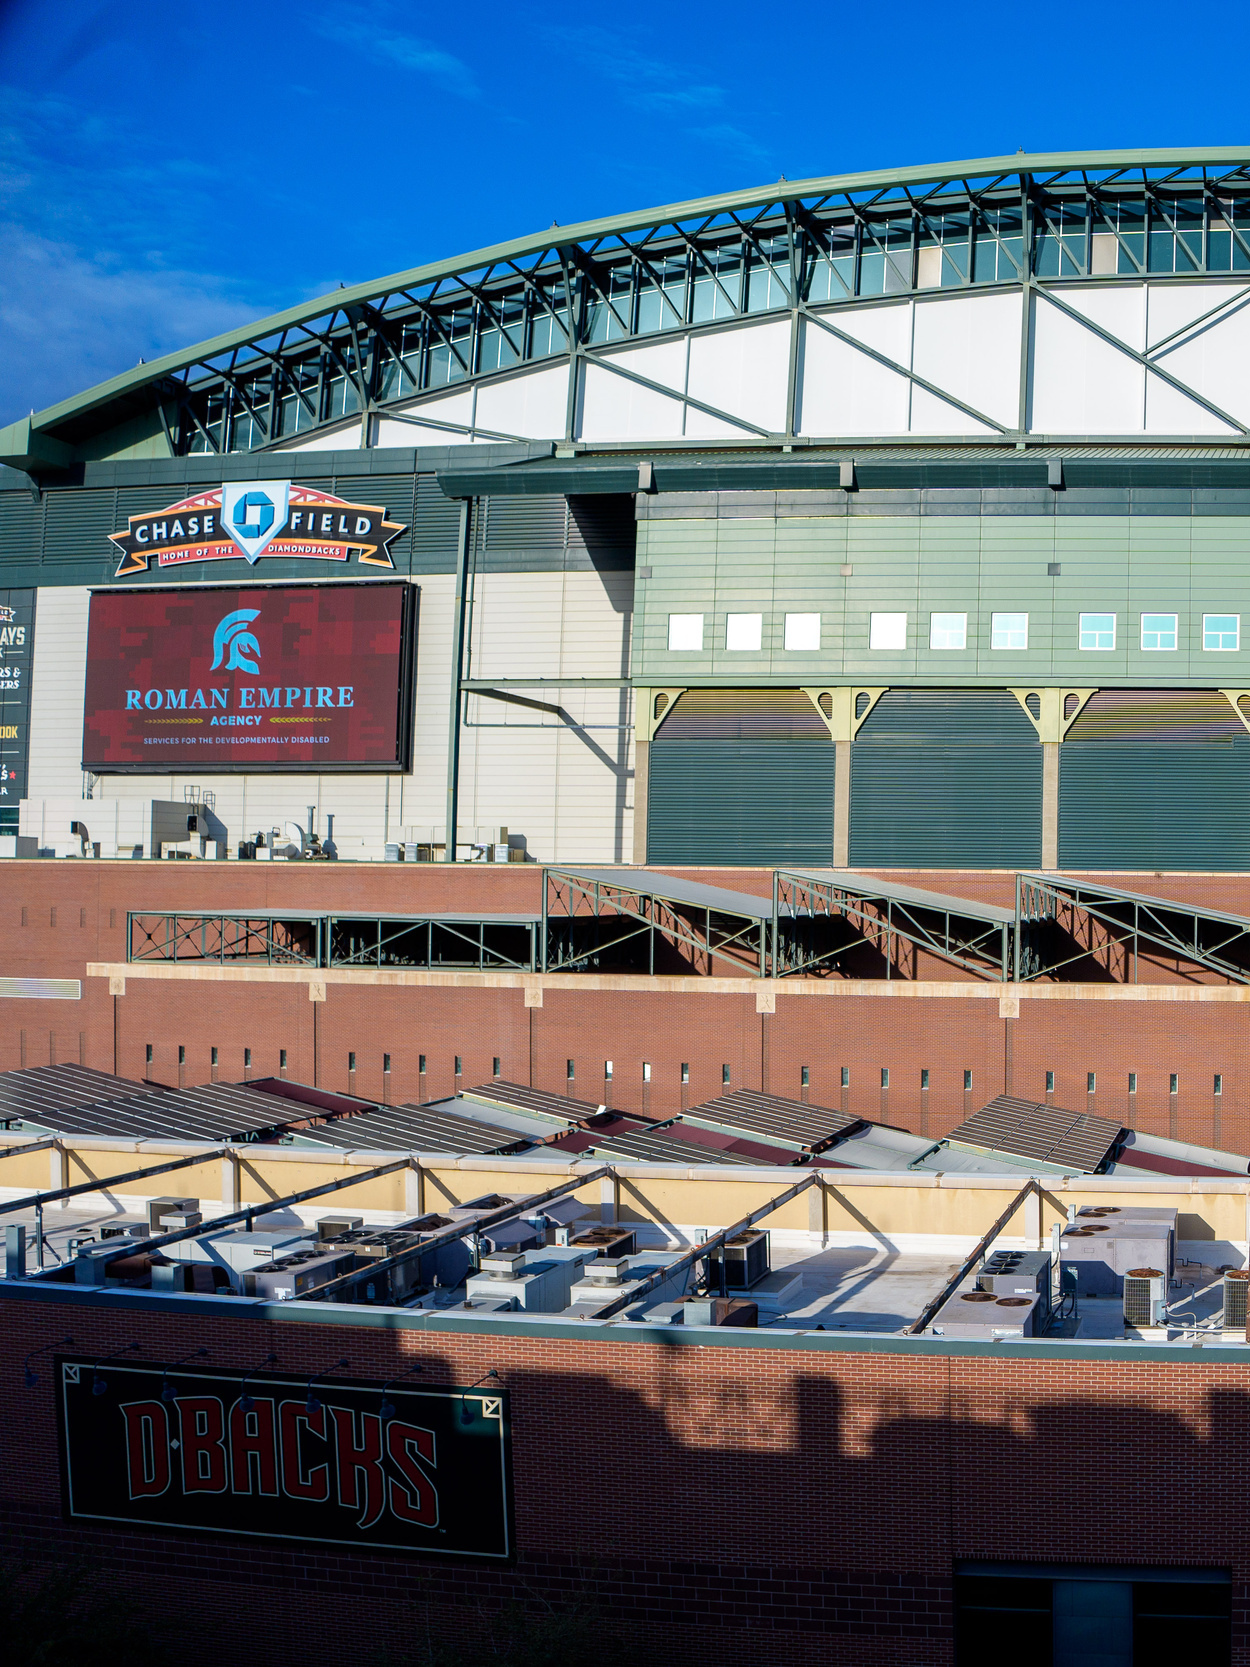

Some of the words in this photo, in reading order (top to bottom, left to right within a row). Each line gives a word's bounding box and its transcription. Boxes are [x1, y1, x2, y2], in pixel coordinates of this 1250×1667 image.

[135, 515, 215, 544] CHASE
[290, 511, 372, 536] FIELD
[162, 551, 190, 561] HOME
[196, 548, 209, 557] OF
[214, 546, 233, 555] THE
[268, 545, 341, 556] DIAMONDBACKS
[125, 688, 230, 711] ROMAN
[239, 686, 355, 709] EMPIRE
[210, 715, 262, 726] AGENCY
[143, 737, 180, 745] SERVICES
[199, 736, 213, 744] THE
[215, 736, 289, 744] DEVELOPMENTALLY
[291, 736, 330, 744] DISABLED
